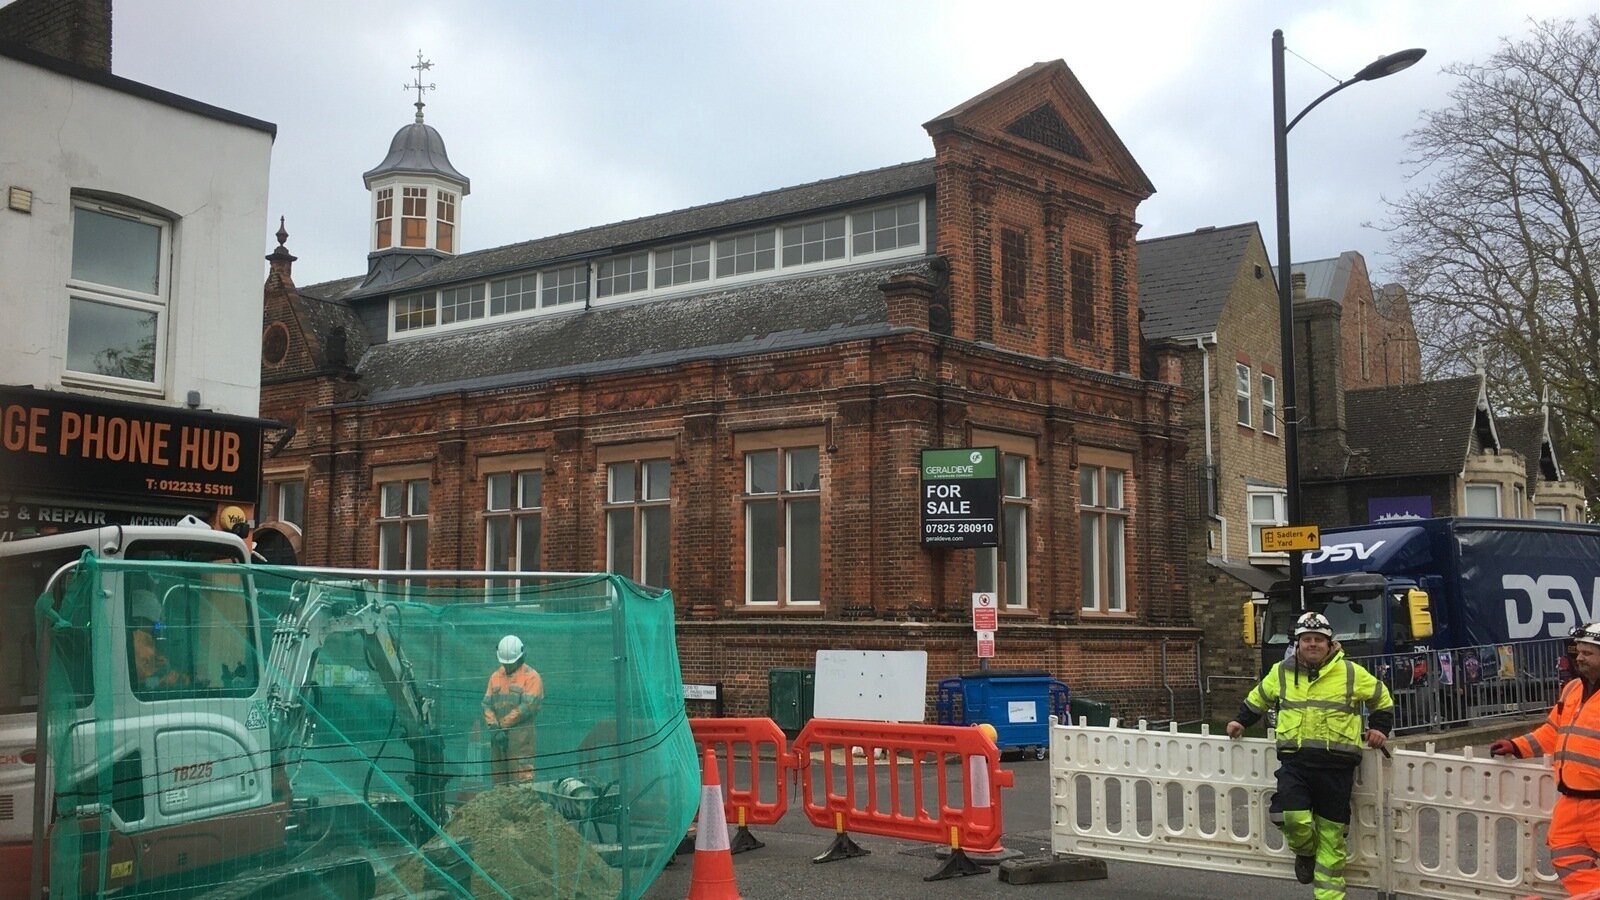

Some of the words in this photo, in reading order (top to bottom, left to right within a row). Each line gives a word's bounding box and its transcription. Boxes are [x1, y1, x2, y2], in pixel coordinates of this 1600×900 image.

[0, 405, 50, 453] GE
[59, 411, 171, 466] PHONE
[179, 426, 241, 473] HUB
[926, 465, 974, 474] GERALDEVE
[146, 478, 158, 490] T:
[160, 480, 202, 493] 012233
[204, 483, 233, 496] 55111
[926, 484, 962, 498] FOR
[17, 506, 31, 520] &
[38, 508, 106, 525] REPAIR
[926, 501, 971, 514] SALE
[228, 515, 245, 523] Yale
[926, 524, 955, 533] 07825
[957, 523, 994, 533] 280910
[1302, 540, 1387, 564] DSV
[1502, 574, 1600, 638] DSV
[173, 763, 213, 782] TB225
